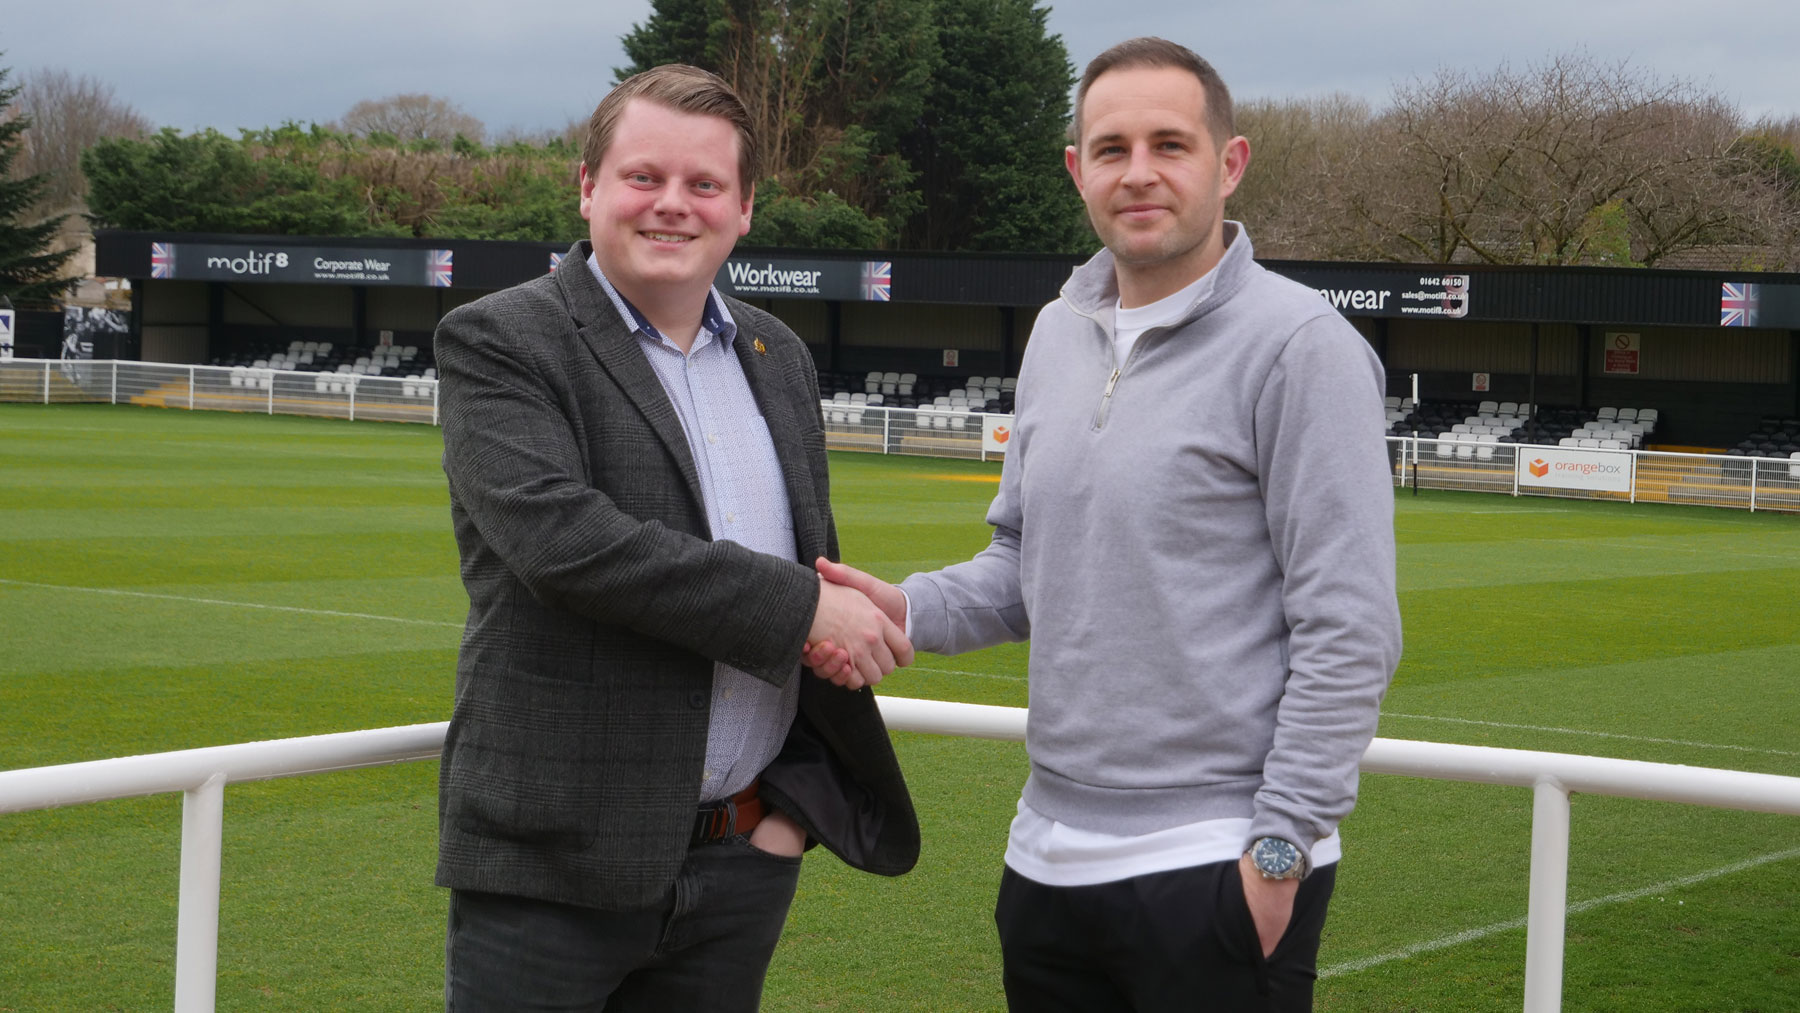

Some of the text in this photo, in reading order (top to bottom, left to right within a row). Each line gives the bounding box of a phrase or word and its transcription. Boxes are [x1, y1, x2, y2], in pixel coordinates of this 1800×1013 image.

[207, 250, 289, 275] motif8
[314, 257, 391, 273] Corporate Wear
[314, 272, 390, 281] www.motif8.co.uk
[728, 262, 821, 287] Workwear
[1420, 277, 1440, 286] 01642
[734, 285, 820, 294] www.motif8.co.uk
[1401, 291, 1466, 301] sales@motif8.co.uk
[1401, 306, 1462, 315] www.motif8.co.uk
[1555, 462, 1621, 475] orangebox
